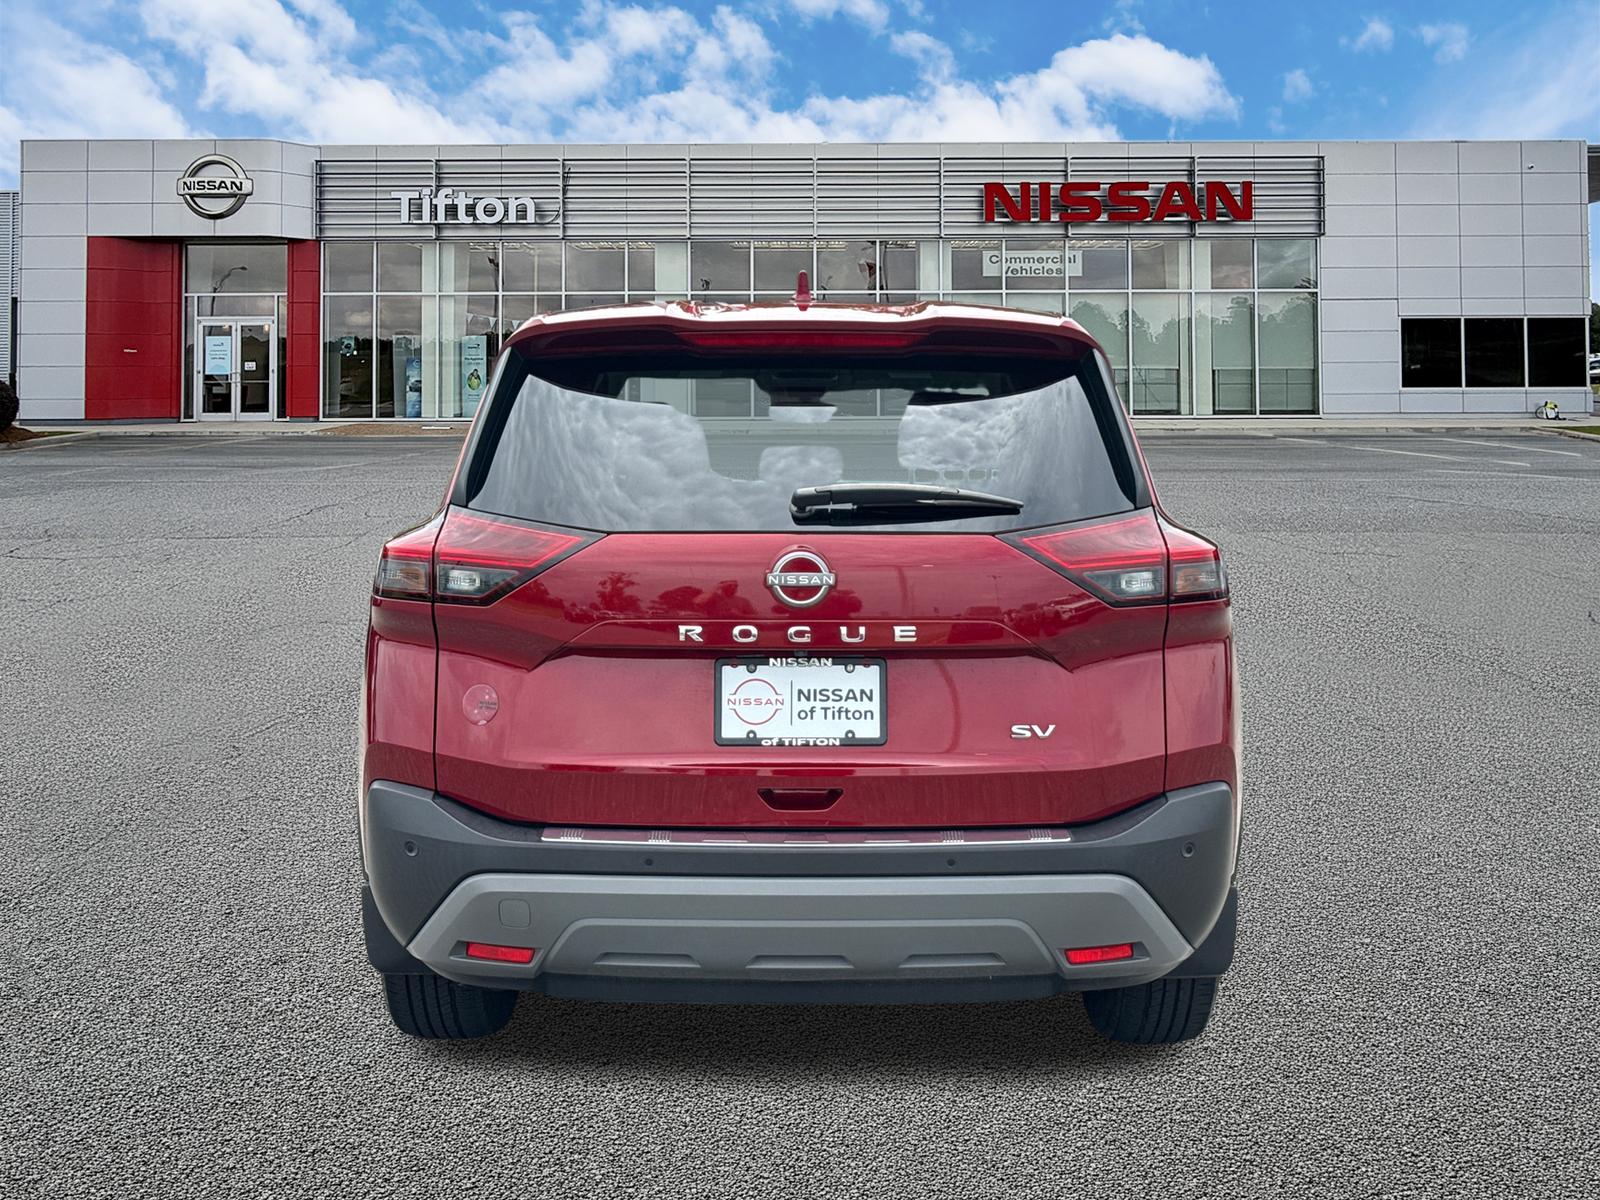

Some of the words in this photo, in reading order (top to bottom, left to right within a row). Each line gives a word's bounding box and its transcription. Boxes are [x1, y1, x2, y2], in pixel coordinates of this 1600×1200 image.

[181, 179, 244, 193] NISSAN
[390, 187, 536, 224] Tifton
[983, 180, 1254, 223] NISSAN
[988, 254, 1077, 265] Cmmercil
[768, 574, 834, 585] NISSAN
[677, 624, 918, 643] ROGUE
[768, 657, 833, 668] NISSAN
[727, 698, 784, 706] NISSAN
[797, 688, 874, 702] NISSAN
[797, 706, 816, 720] of
[820, 706, 874, 720] Tifton
[1010, 724, 1057, 739] SV
[761, 737, 779, 746] of
[782, 737, 840, 746] TIFTON
